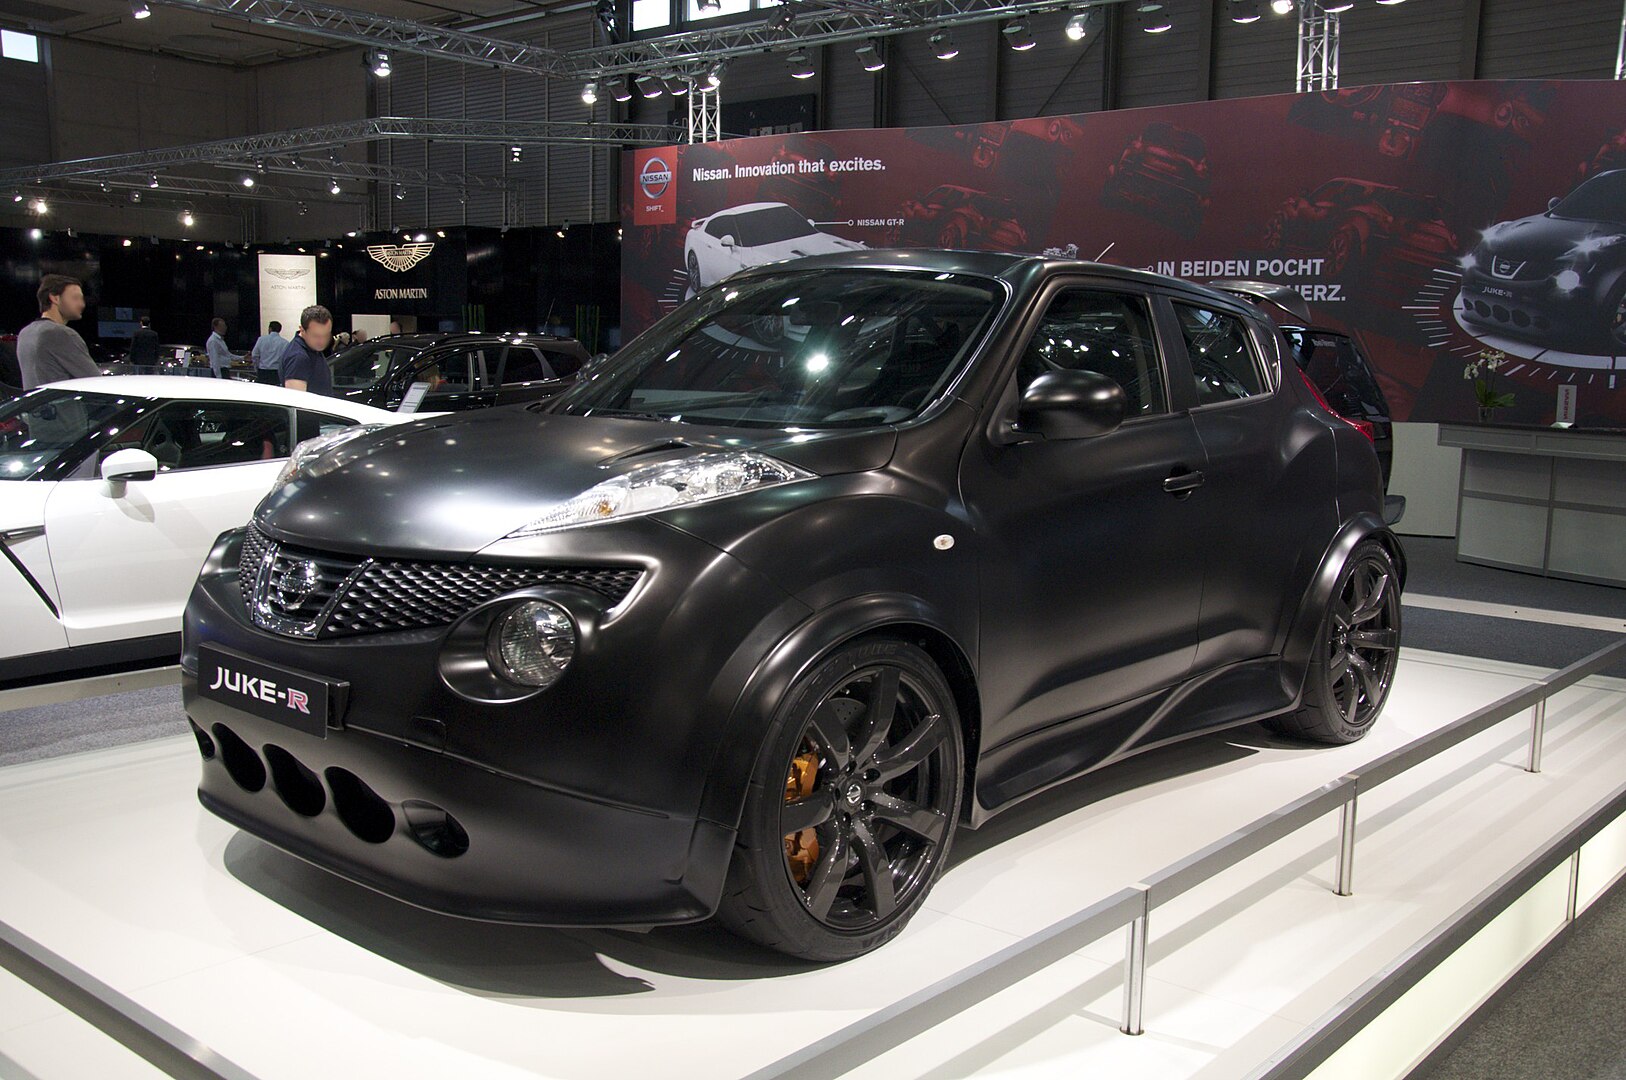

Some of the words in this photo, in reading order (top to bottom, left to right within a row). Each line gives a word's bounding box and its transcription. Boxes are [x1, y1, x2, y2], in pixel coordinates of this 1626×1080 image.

[642, 173, 669, 182] NISSAN
[693, 167, 732, 182] Nissan.
[735, 164, 795, 179] Innovation
[798, 159, 825, 173] that
[829, 157, 886, 172] excites.
[857, 219, 885, 227] NISSAN
[886, 218, 905, 226] GT-R
[1157, 261, 1175, 277] IN
[1180, 260, 1250, 277] BEIDEN
[1255, 258, 1325, 277] POCHT
[374, 288, 398, 300] ASTON
[399, 287, 428, 299] MARTIN
[209, 666, 311, 715] JUKE-R
